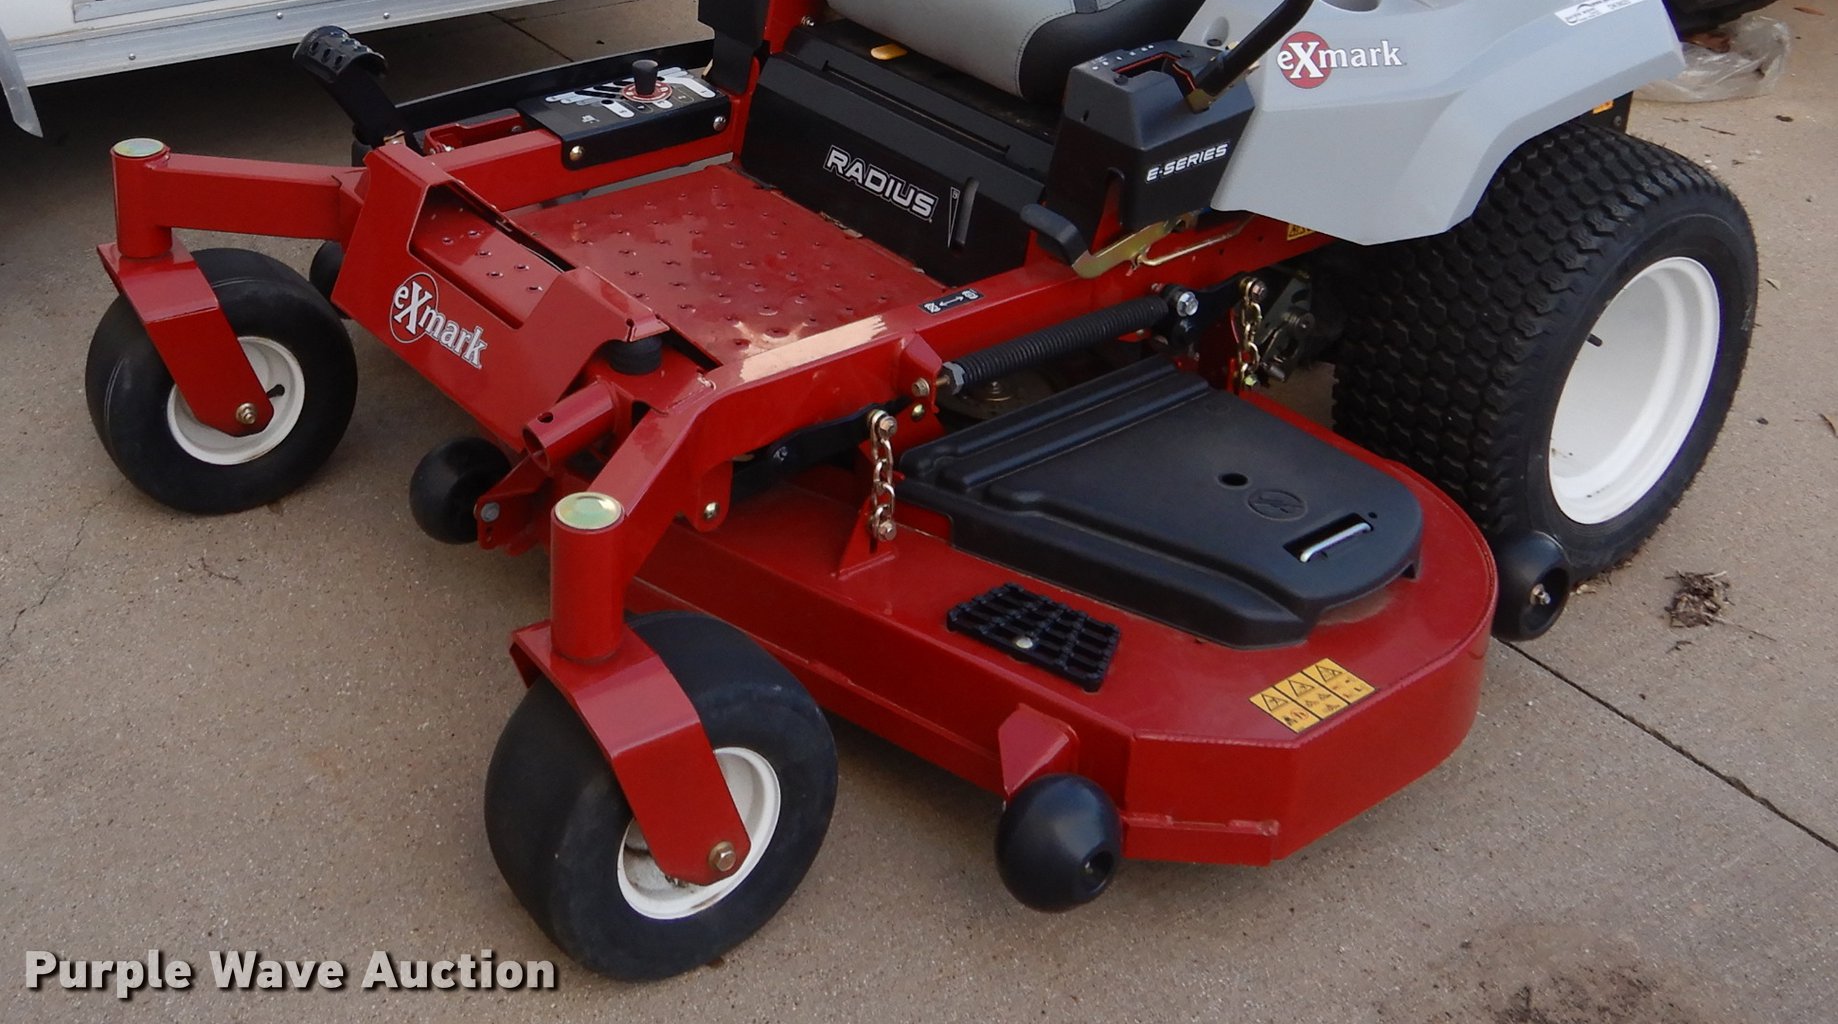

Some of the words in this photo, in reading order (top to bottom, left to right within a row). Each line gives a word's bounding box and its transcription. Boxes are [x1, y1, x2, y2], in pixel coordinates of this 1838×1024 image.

[1277, 40, 1403, 79] eXmark
[826, 147, 937, 218] RADIUS
[1146, 143, 1228, 182] E-SERIES
[392, 280, 487, 366] eXmark
